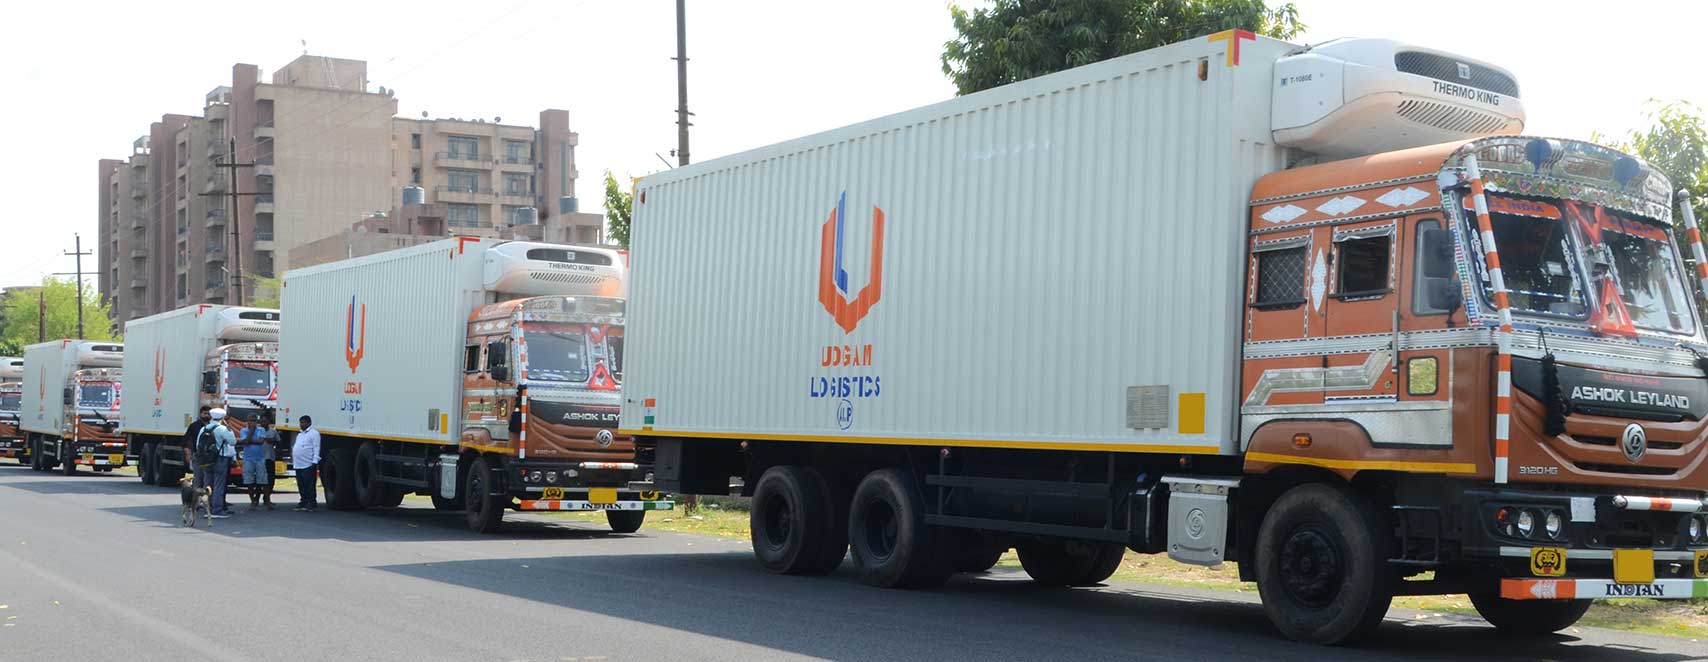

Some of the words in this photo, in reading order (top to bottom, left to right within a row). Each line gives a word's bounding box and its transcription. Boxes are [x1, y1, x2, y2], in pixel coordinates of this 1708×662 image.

[1433, 80, 1475, 100] THERMO
[1477, 92, 1499, 106] KING
[548, 262, 577, 271] THERMO
[578, 264, 595, 272] KING
[821, 344, 872, 367] UDGAM
[810, 376, 880, 398] LOGISTICS
[1571, 386, 1625, 402] ASHOK
[1630, 390, 1689, 409] LEYLAND
[563, 412, 599, 421] ASHOK
[601, 413, 620, 421] LEY
[1606, 583, 1665, 596] INDIAN
